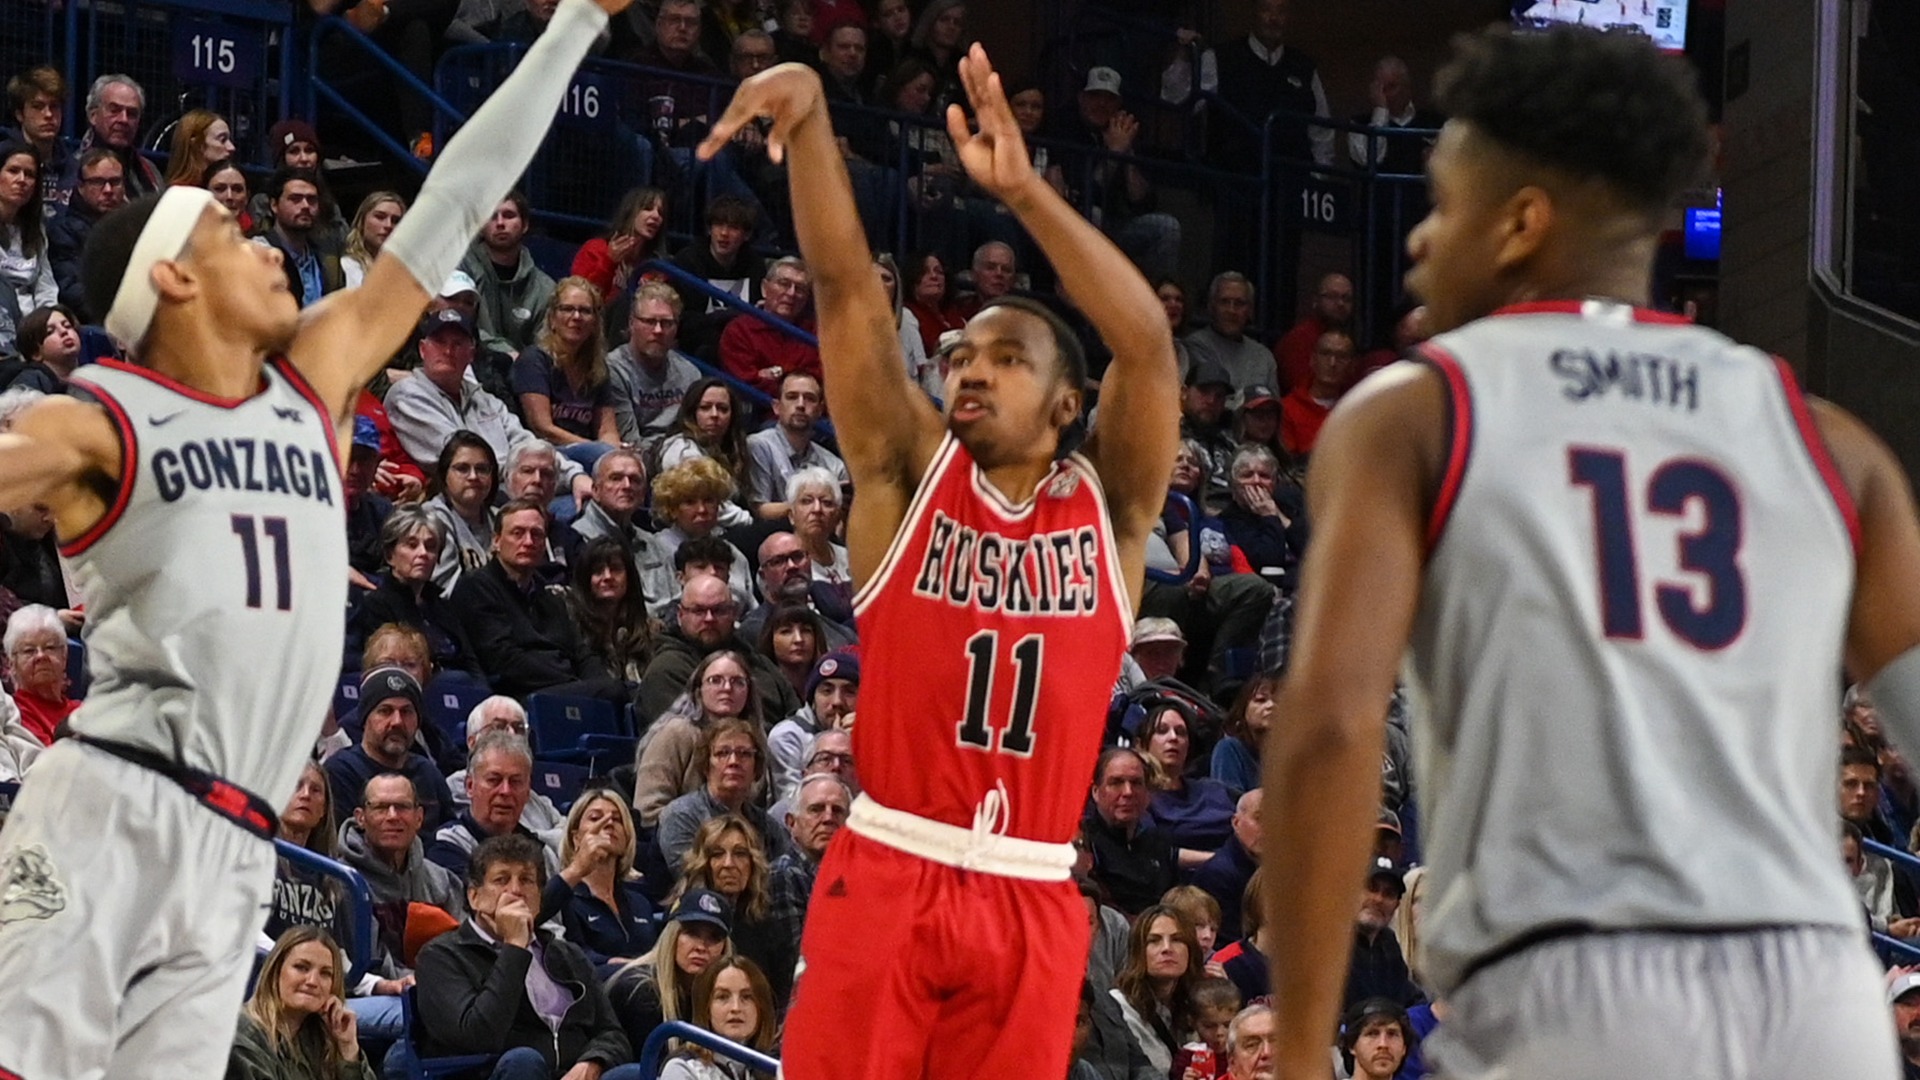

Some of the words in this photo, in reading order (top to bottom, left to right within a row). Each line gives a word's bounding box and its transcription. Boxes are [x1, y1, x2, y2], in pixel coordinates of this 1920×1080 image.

[191, 34, 235, 73] 115
[1301, 188, 1335, 222] 116
[1549, 348, 1699, 412] SMITH
[152, 437, 333, 507] GONZAGA
[231, 512, 292, 612] 11
[912, 509, 1098, 618] HUSKIES
[1566, 443, 1748, 652] 13
[956, 628, 1044, 758] 11
